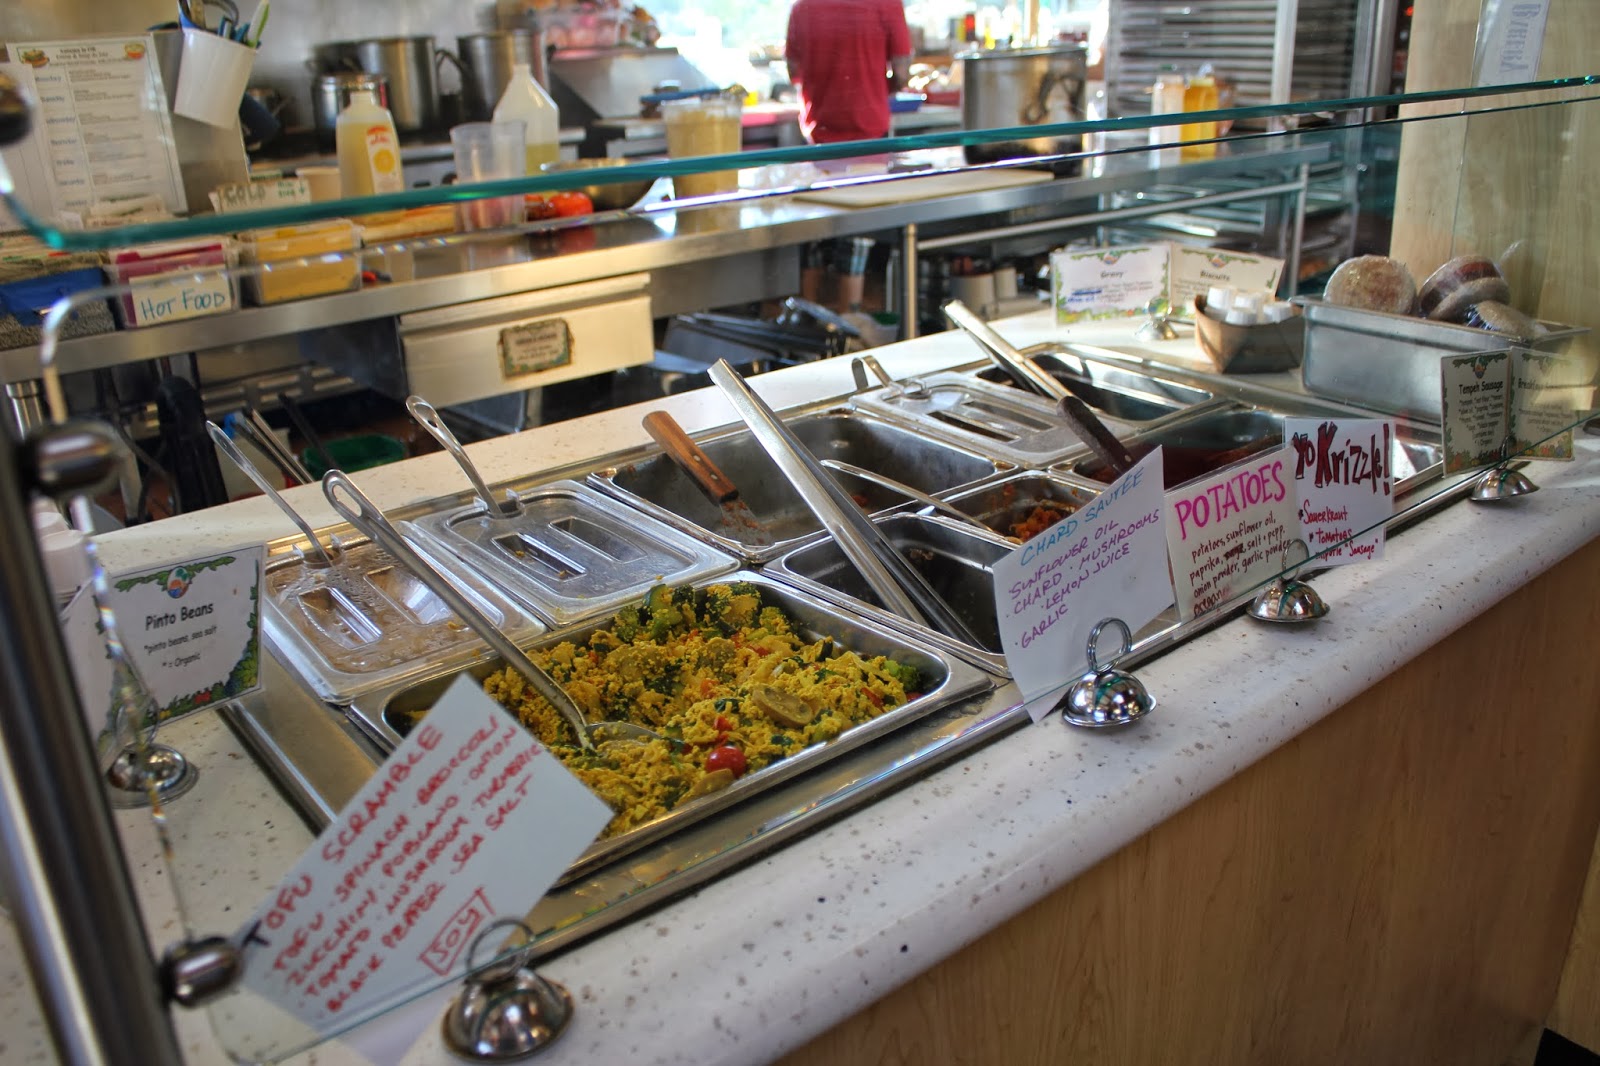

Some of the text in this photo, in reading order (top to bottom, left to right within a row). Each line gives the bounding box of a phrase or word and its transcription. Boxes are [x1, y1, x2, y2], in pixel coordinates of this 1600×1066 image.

[1458, 380, 1504, 396] Tempeh Sausage
[1174, 460, 1286, 541] POTATOES
[1020, 520, 1079, 567] CHARD
[1226, 520, 1263, 543] sunflower
[1246, 533, 1262, 551] salt
[1010, 520, 1120, 601] SUNFLOWER OIL
[1013, 508, 1160, 615] CHARD MUSHROOMS
[1044, 542, 1131, 610] LEMON JUICE
[1193, 580, 1212, 599] onion
[1241, 548, 1263, 574] garlic
[145, 603, 214, 632] Pinto Beans
[204, 624, 218, 637] salt
[1020, 603, 1068, 649] GARLIC
[174, 652, 201, 668] Organic
[240, 724, 444, 950] TOFU SCRAMBLE
[272, 713, 499, 971] TOFU SPINACH BROCCOLI
[286, 887, 379, 987] ZUCCHINI
[468, 725, 518, 782] ONION
[304, 926, 371, 997] TOMATO
[386, 814, 470, 916] MUSHROOM
[325, 952, 384, 1013] BLACK
[450, 832, 485, 875] SEA
[484, 773, 533, 832] SALT
[437, 908, 480, 959] SOY
